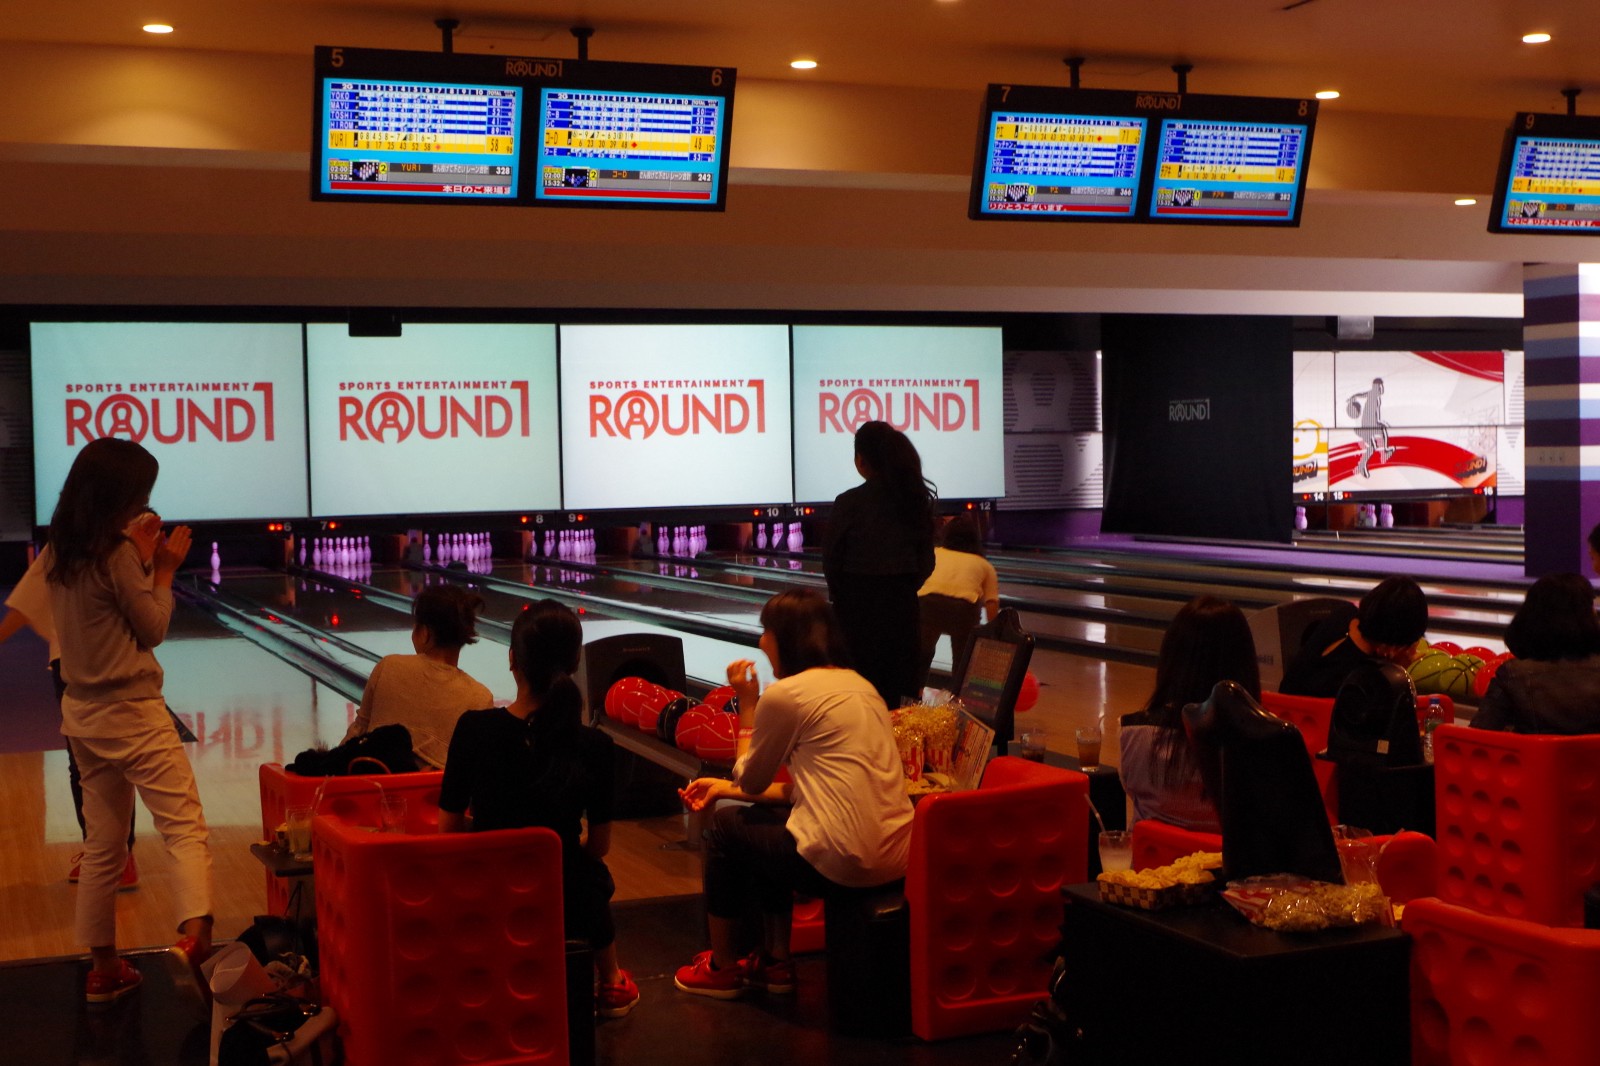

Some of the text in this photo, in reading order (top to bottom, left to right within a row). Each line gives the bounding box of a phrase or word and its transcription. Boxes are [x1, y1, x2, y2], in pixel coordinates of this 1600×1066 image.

[332, 50, 344, 68] 5
[506, 60, 562, 78] ROUND1
[712, 68, 722, 86] 6
[331, 92, 350, 100] YOKO
[1001, 86, 1011, 102] 7
[330, 102, 350, 110] MAYU
[1298, 100, 1308, 116] 8
[331, 112, 353, 120] TOSHI
[1526, 114, 1535, 130] 9
[330, 132, 348, 147] YURI
[402, 163, 421, 172] YURI
[496, 166, 510, 175] 328
[698, 174, 712, 182] 242
[66, 382, 250, 392] SPORTS ENTERTAINMENT
[339, 380, 507, 390] SPORTS ENTERTAINMENT
[590, 380, 744, 389] SPORTS ENTERTAINMENT
[820, 378, 962, 387] SPORTS ENTERTAINMENT
[589, 379, 766, 440] ROUND1
[818, 378, 980, 434] ROUND1
[65, 382, 274, 446] ROUND1
[338, 380, 530, 444] ROUND1
[1333, 492, 1343, 500] 15
[1484, 487, 1494, 496] 16
[1314, 492, 1324, 502] 14
[980, 502, 991, 510] 12
[766, 508, 778, 517] 10
[794, 508, 804, 516] 11
[536, 515, 544, 524] 8
[568, 514, 576, 522] 9
[320, 521, 328, 530] 7
